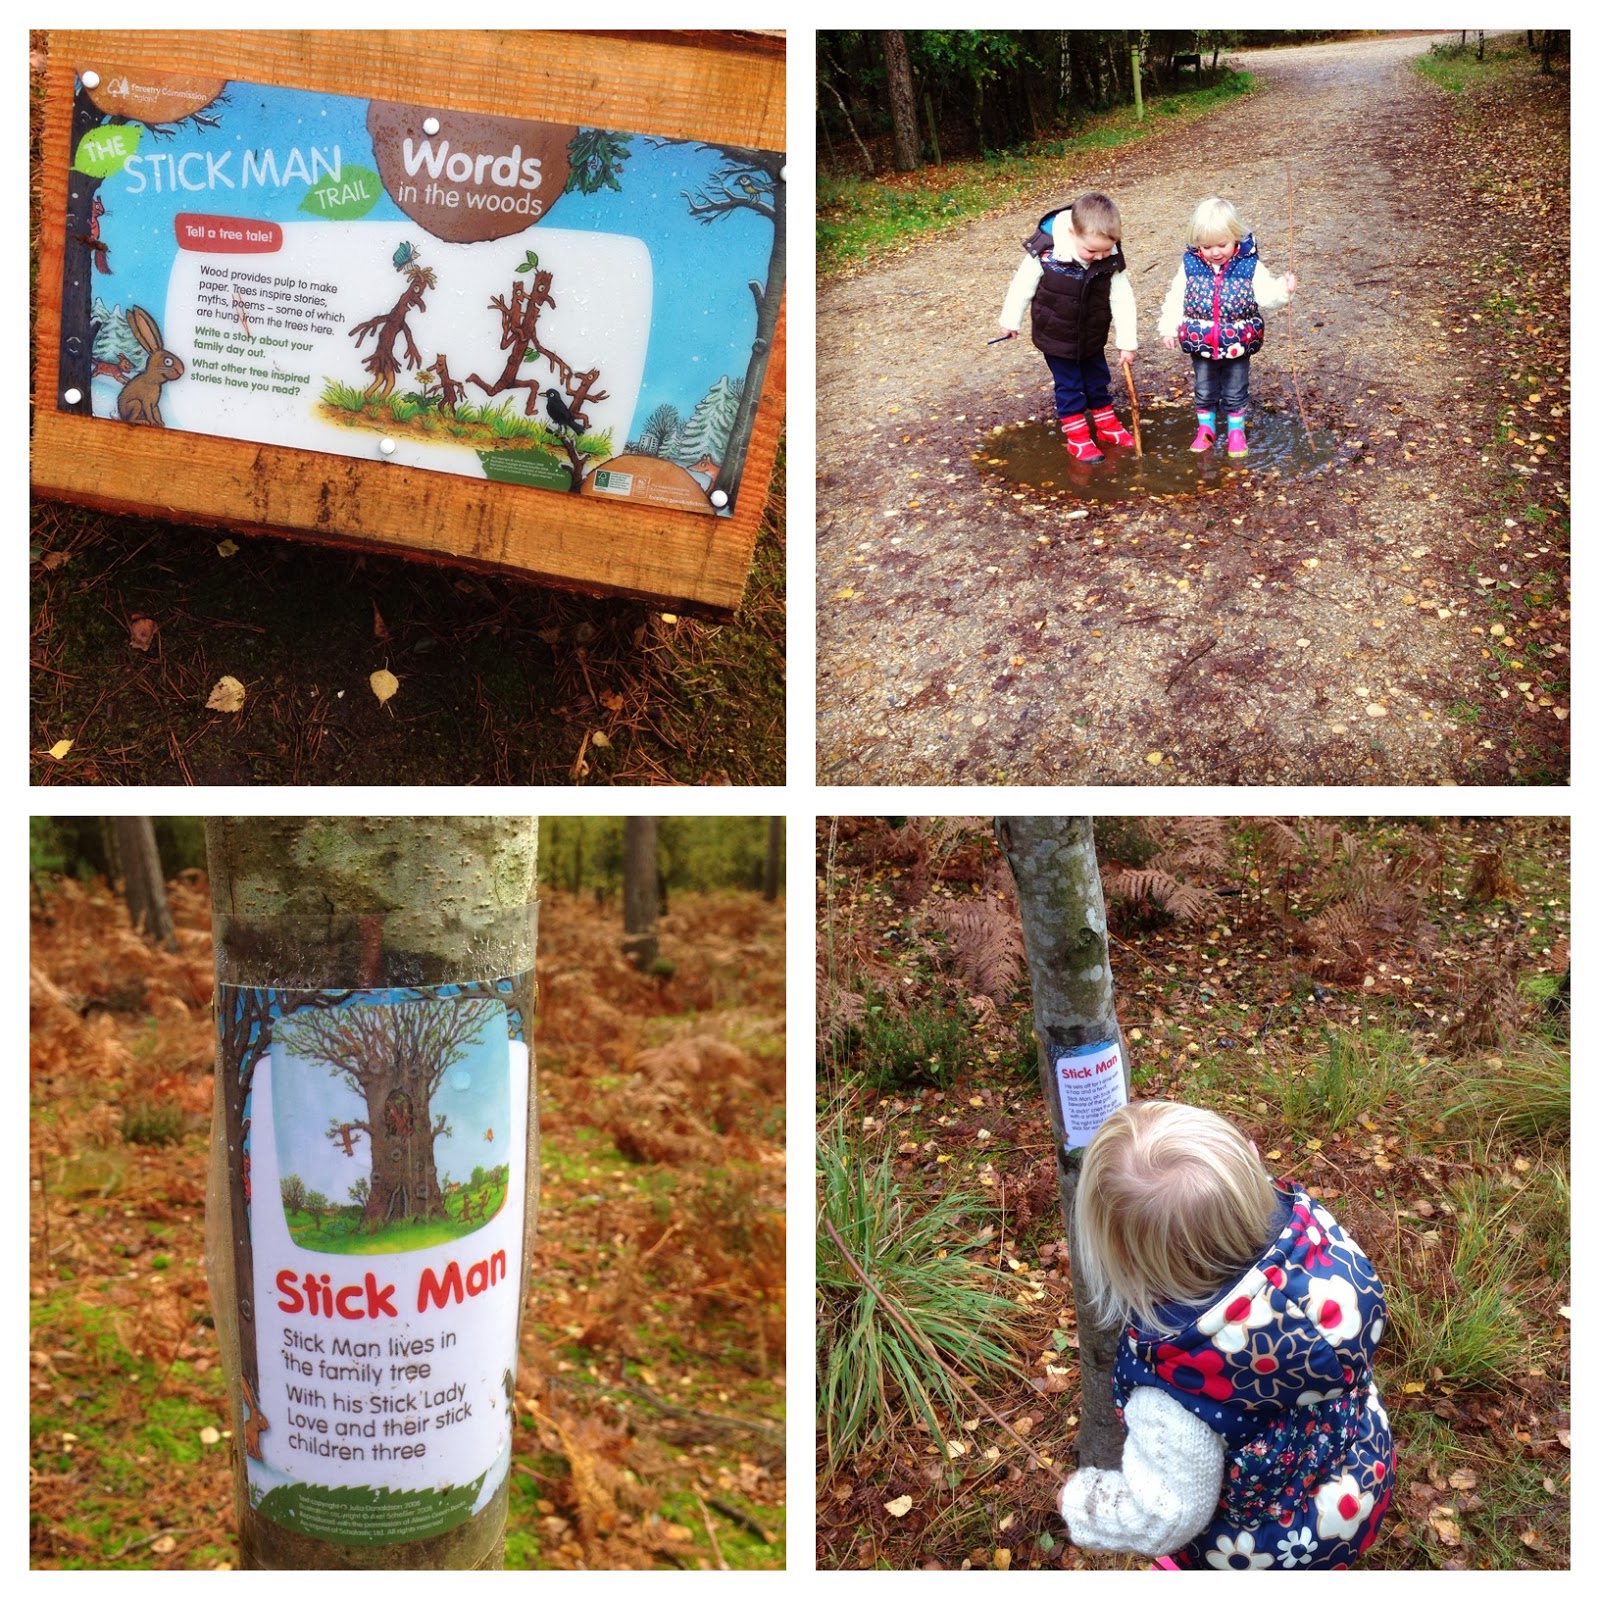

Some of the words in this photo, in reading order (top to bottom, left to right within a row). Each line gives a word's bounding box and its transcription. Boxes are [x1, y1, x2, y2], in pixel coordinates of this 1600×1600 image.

[131, 84, 160, 95] Forestry
[162, 88, 207, 101] Commission
[83, 135, 127, 163] THE
[123, 150, 236, 194] STICK
[242, 144, 341, 189] MAN
[403, 138, 542, 190] Words
[315, 180, 370, 210] TRAIL
[398, 181, 417, 202] in
[424, 183, 459, 208] the
[467, 193, 543, 216] woods
[186, 226, 205, 238] Tell
[208, 230, 216, 239] a
[219, 228, 243, 241] tree
[246, 230, 273, 242] tale!
[200, 265, 228, 278] Wood
[231, 269, 272, 284] provides
[274, 275, 296, 289] pulp
[298, 279, 308, 290] to
[310, 281, 338, 294] make
[198, 293, 229, 308] myths,
[232, 299, 265, 314] poems
[276, 306, 303, 317] some
[305, 308, 316, 319] of
[317, 310, 345, 323] which
[199, 280, 230, 293] paper.
[232, 284, 257, 296] Trees
[259, 288, 291, 303] inspire
[294, 292, 328, 308] stories,
[196, 308, 213, 318] are
[215, 309, 240, 324] hung
[242, 312, 264, 324] from
[267, 316, 282, 328] the
[285, 319, 308, 332] trees
[311, 323, 335, 336] here.
[194, 339, 224, 354] family
[226, 344, 245, 358] day
[247, 348, 266, 359] out.
[195, 326, 222, 338] Write
[224, 331, 230, 340] a
[233, 331, 257, 346] story
[259, 335, 289, 348] about
[291, 341, 314, 353] your
[190, 371, 222, 385] stories
[225, 376, 249, 388] have
[251, 381, 269, 393] you
[272, 382, 300, 396] read?
[192, 358, 219, 371] What
[221, 362, 247, 375] other
[249, 367, 269, 379] tree
[271, 369, 310, 385] inspired
[1061, 1067, 1092, 1079] Stick
[1095, 1055, 1117, 1075] Man
[275, 1269, 398, 1320] Stick
[416, 1248, 506, 1314] Man
[283, 1327, 324, 1354] Stick
[331, 1338, 381, 1358] Man
[389, 1336, 435, 1356] lives
[441, 1330, 457, 1350] in
[284, 1353, 313, 1377] the
[319, 1357, 382, 1386] family
[390, 1363, 431, 1382] tree
[285, 1383, 326, 1409] With
[333, 1392, 363, 1414] his
[369, 1392, 417, 1415] Stick
[424, 1381, 467, 1409] Lady
[288, 1407, 328, 1434] Love
[335, 1417, 376, 1437] and
[383, 1415, 429, 1437] their
[435, 1402, 472, 1430] stick
[288, 1435, 364, 1461] children
[371, 1442, 426, 1461] three
